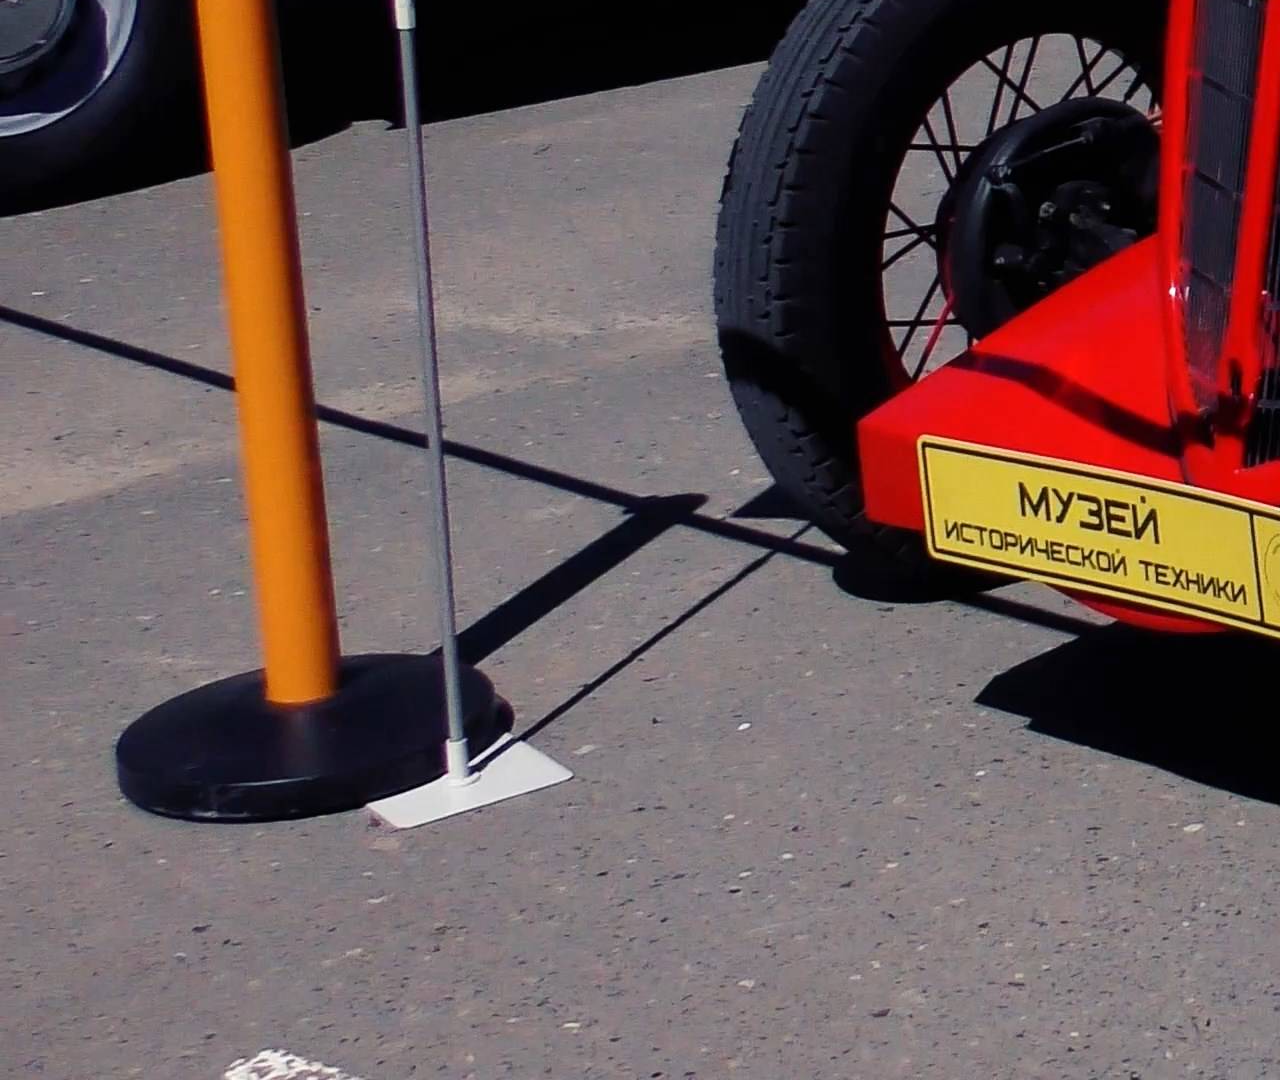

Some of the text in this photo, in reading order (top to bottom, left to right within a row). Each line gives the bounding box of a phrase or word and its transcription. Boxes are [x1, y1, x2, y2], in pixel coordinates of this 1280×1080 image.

[1018, 481, 1160, 545] МУЗЕЙ
[944, 519, 1247, 606] ИСТОРИЧЕСКОЙ ТЕХНИКИ
